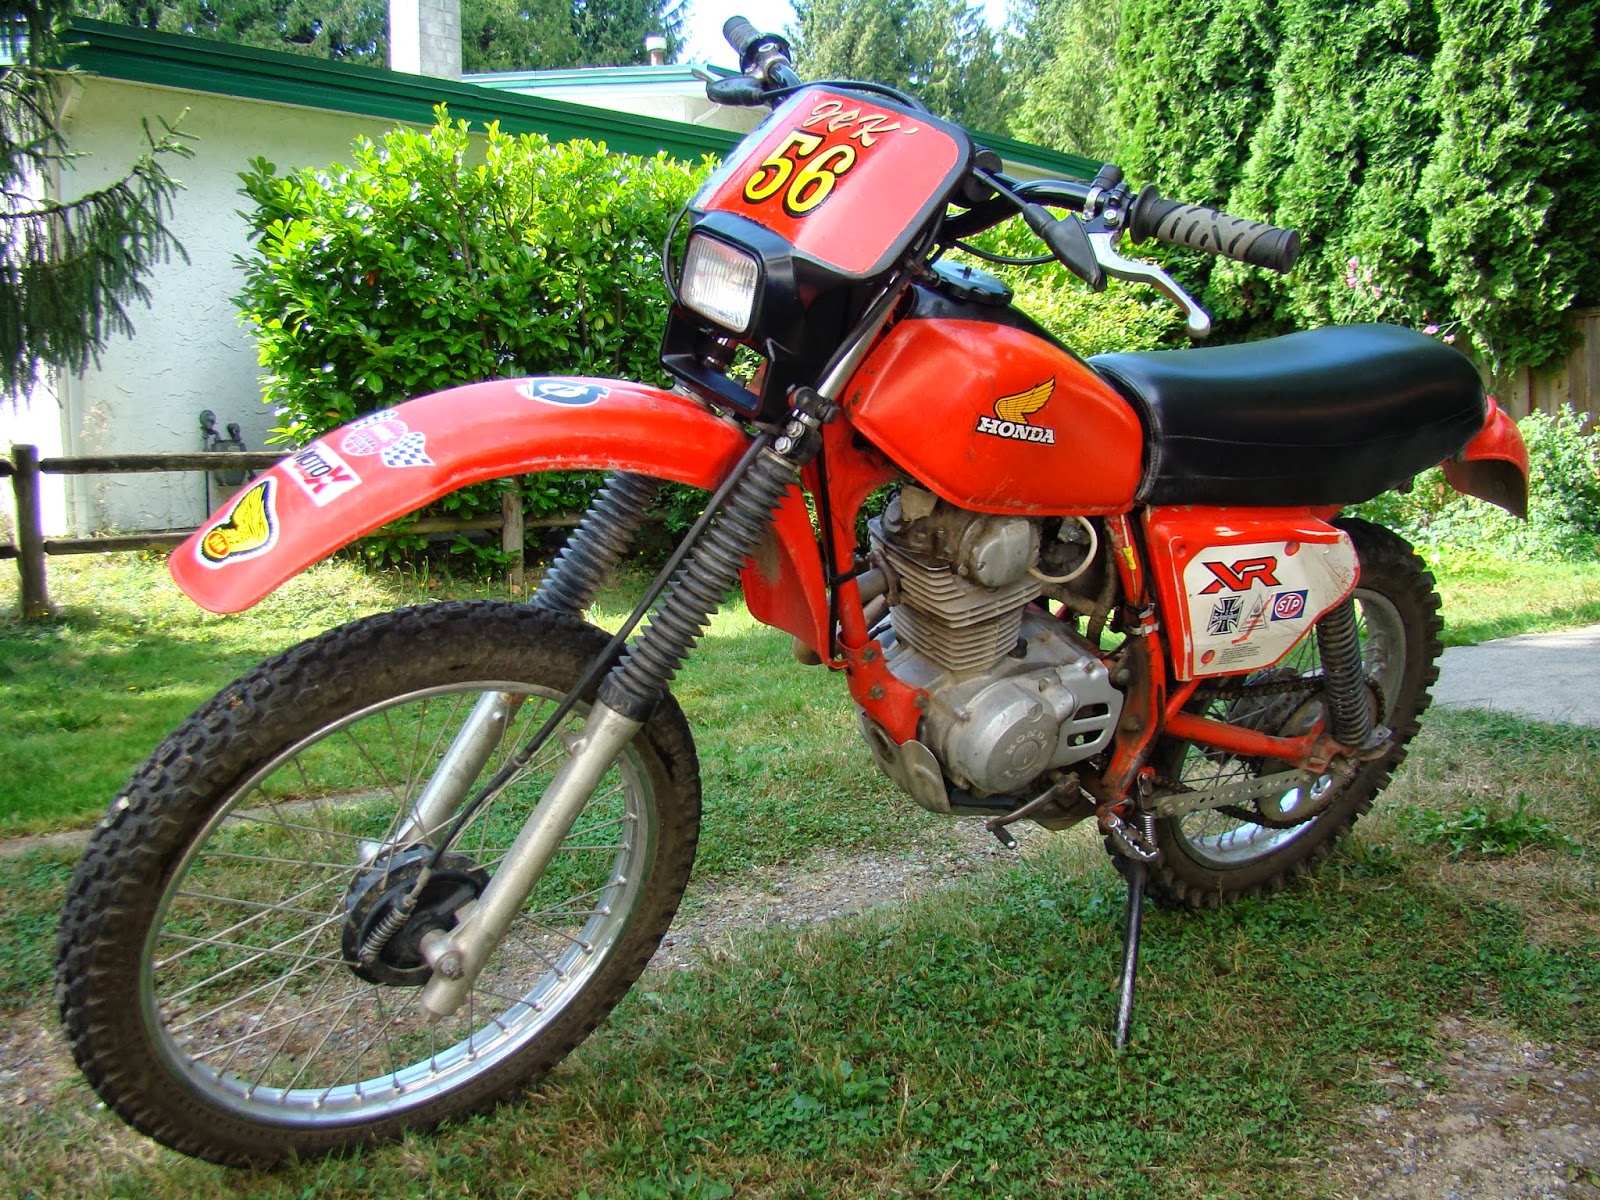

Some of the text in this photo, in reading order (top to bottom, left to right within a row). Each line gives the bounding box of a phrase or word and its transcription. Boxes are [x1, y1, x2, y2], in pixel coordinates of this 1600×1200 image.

[742, 128, 858, 218] 56
[976, 415, 1055, 444] HONDA
[1197, 555, 1282, 595] XR
[1277, 595, 1300, 617] STP
